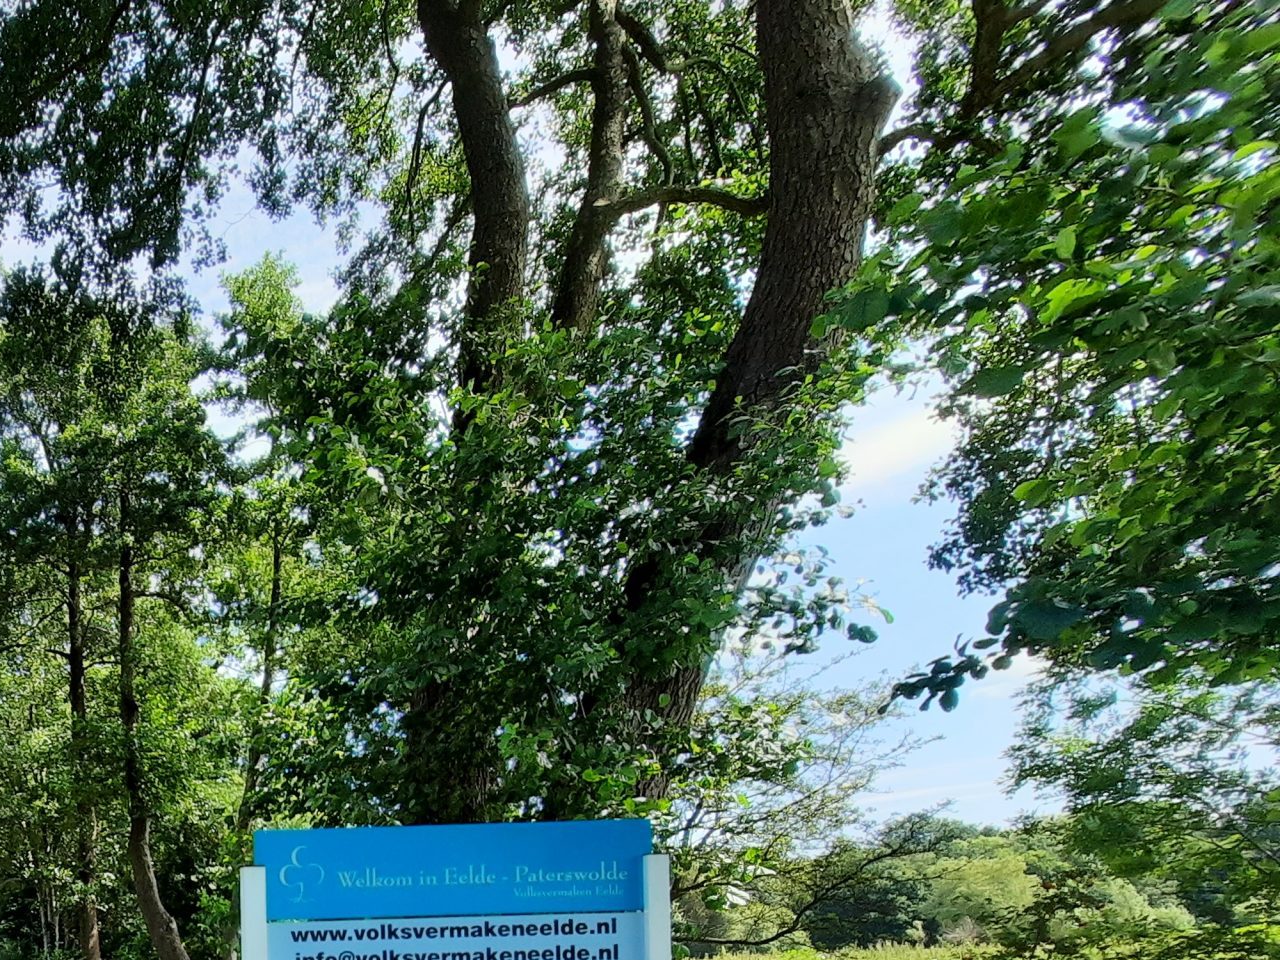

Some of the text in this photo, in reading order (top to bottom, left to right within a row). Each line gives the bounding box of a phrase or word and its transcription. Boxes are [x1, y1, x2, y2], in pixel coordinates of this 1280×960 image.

[337, 867, 412, 888] Welkom
[419, 870, 437, 886] in
[445, 865, 496, 886] Eelde
[514, 861, 628, 883] Paterswolde
[595, 884, 624, 896] Eelde
[291, 917, 618, 942] www.volksvermakeneelde.nl
